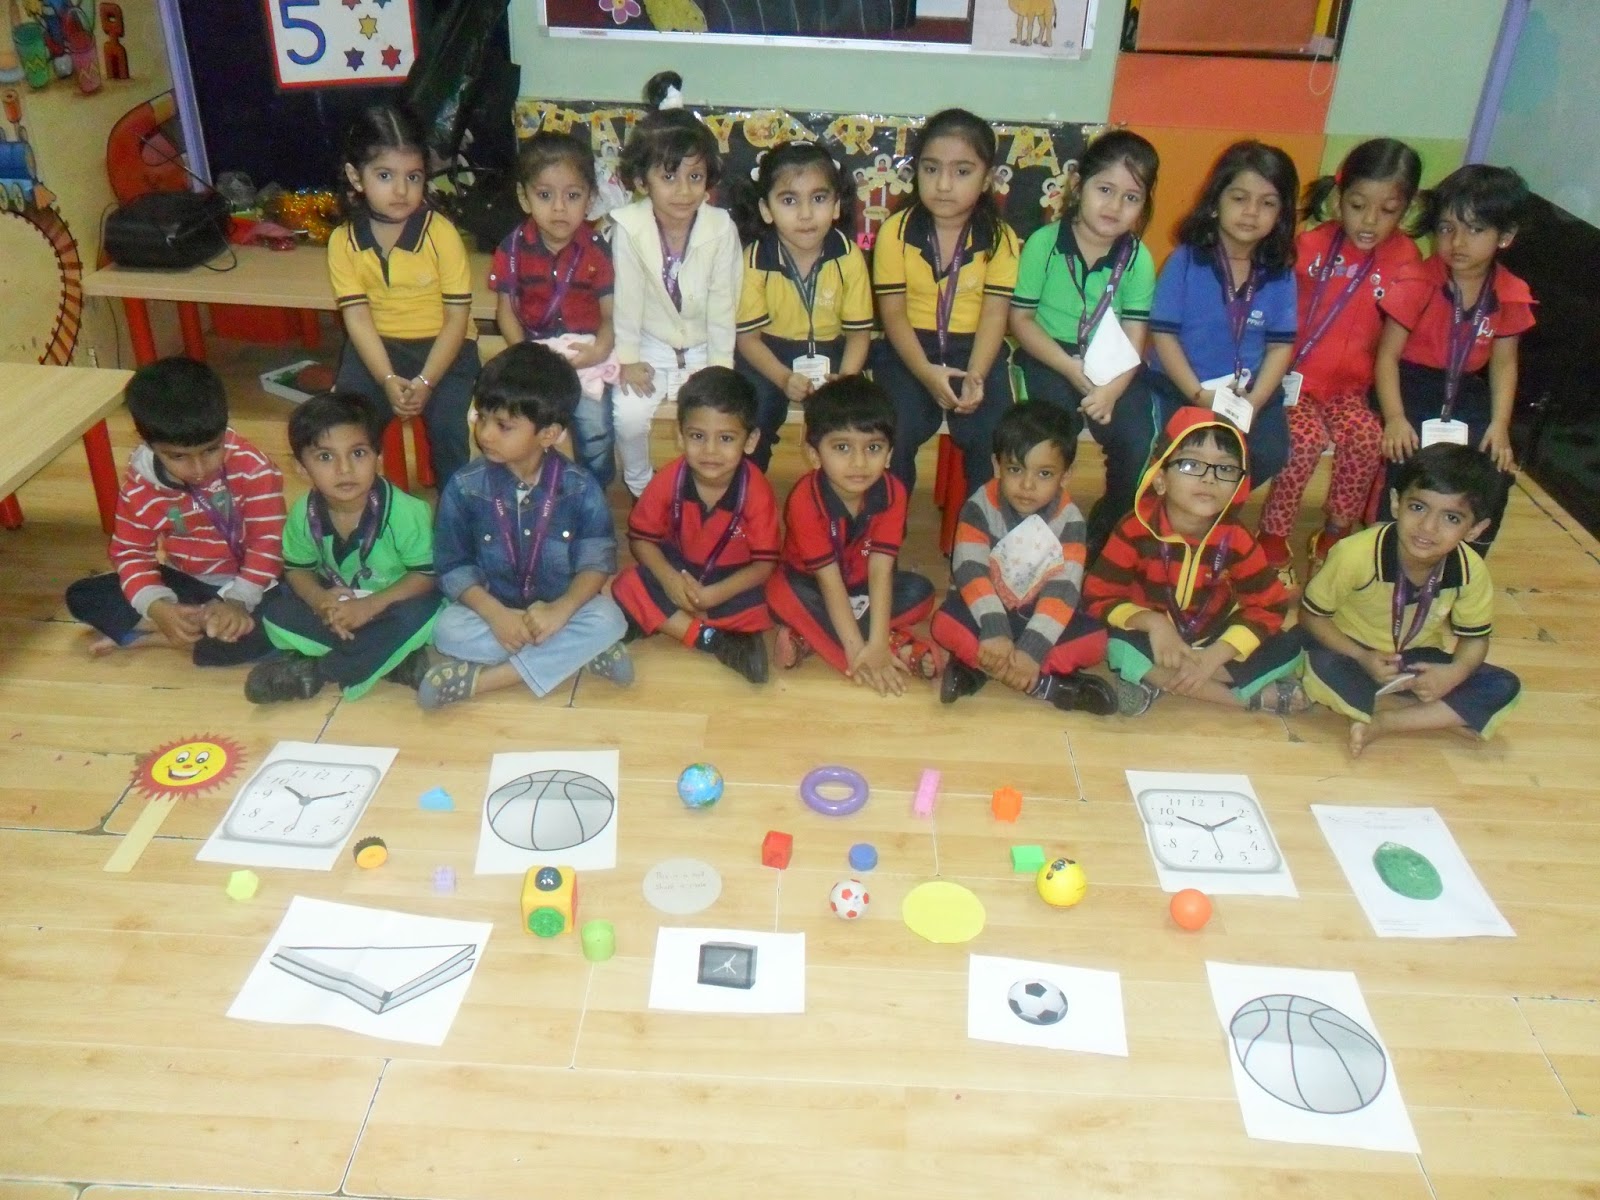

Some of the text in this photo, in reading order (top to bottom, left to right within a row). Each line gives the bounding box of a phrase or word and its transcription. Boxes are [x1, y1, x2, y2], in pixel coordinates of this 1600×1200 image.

[279, 0, 326, 65] 5
[542, 500, 551, 517] WITTY
[1214, 553, 1222, 571] WITTY
[313, 770, 330, 780] 12
[1169, 798, 1181, 806] 11
[1191, 798, 1204, 807] 12
[248, 808, 261, 818] 8
[1238, 809, 1245, 818] 2
[1169, 838, 1177, 848] 8
[1250, 841, 1258, 850] 4
[1191, 850, 1199, 860] 7
[1214, 851, 1224, 861] 6
[1240, 851, 1248, 861] 5
